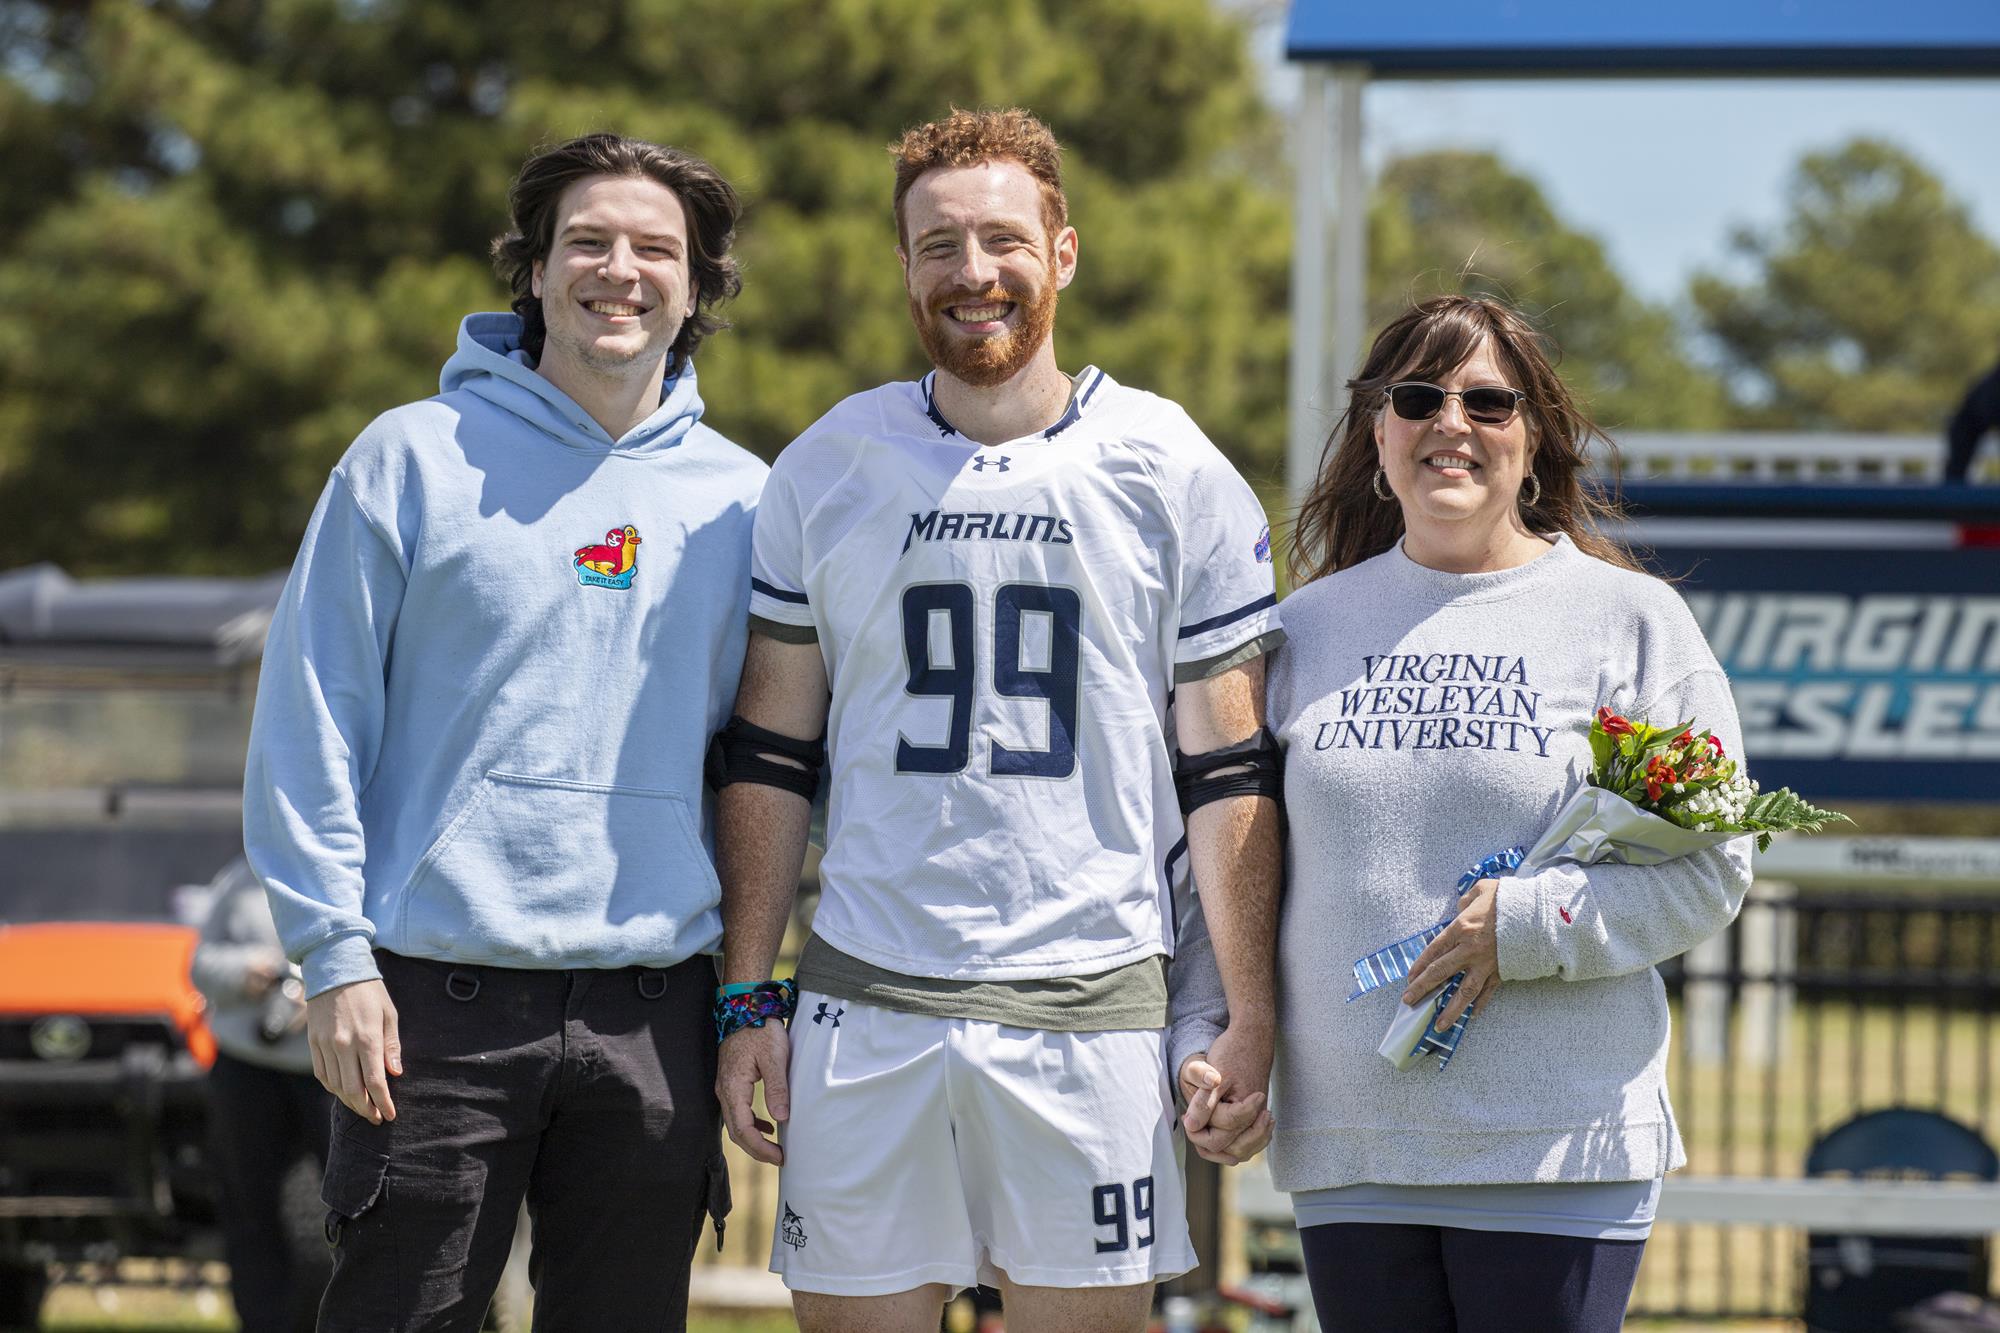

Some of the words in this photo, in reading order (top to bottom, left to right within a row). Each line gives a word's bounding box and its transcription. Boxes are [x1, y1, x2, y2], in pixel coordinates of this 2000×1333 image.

[585, 575, 600, 584] TAKE
[607, 578, 625, 586] EASY
[895, 580, 1083, 782] 99
[1363, 653, 1529, 686] VIRGINIA
[1340, 685, 1542, 722] WESLEYAN
[1314, 717, 1555, 757] UNIVERSITY
[1093, 1175, 1155, 1253] 99
